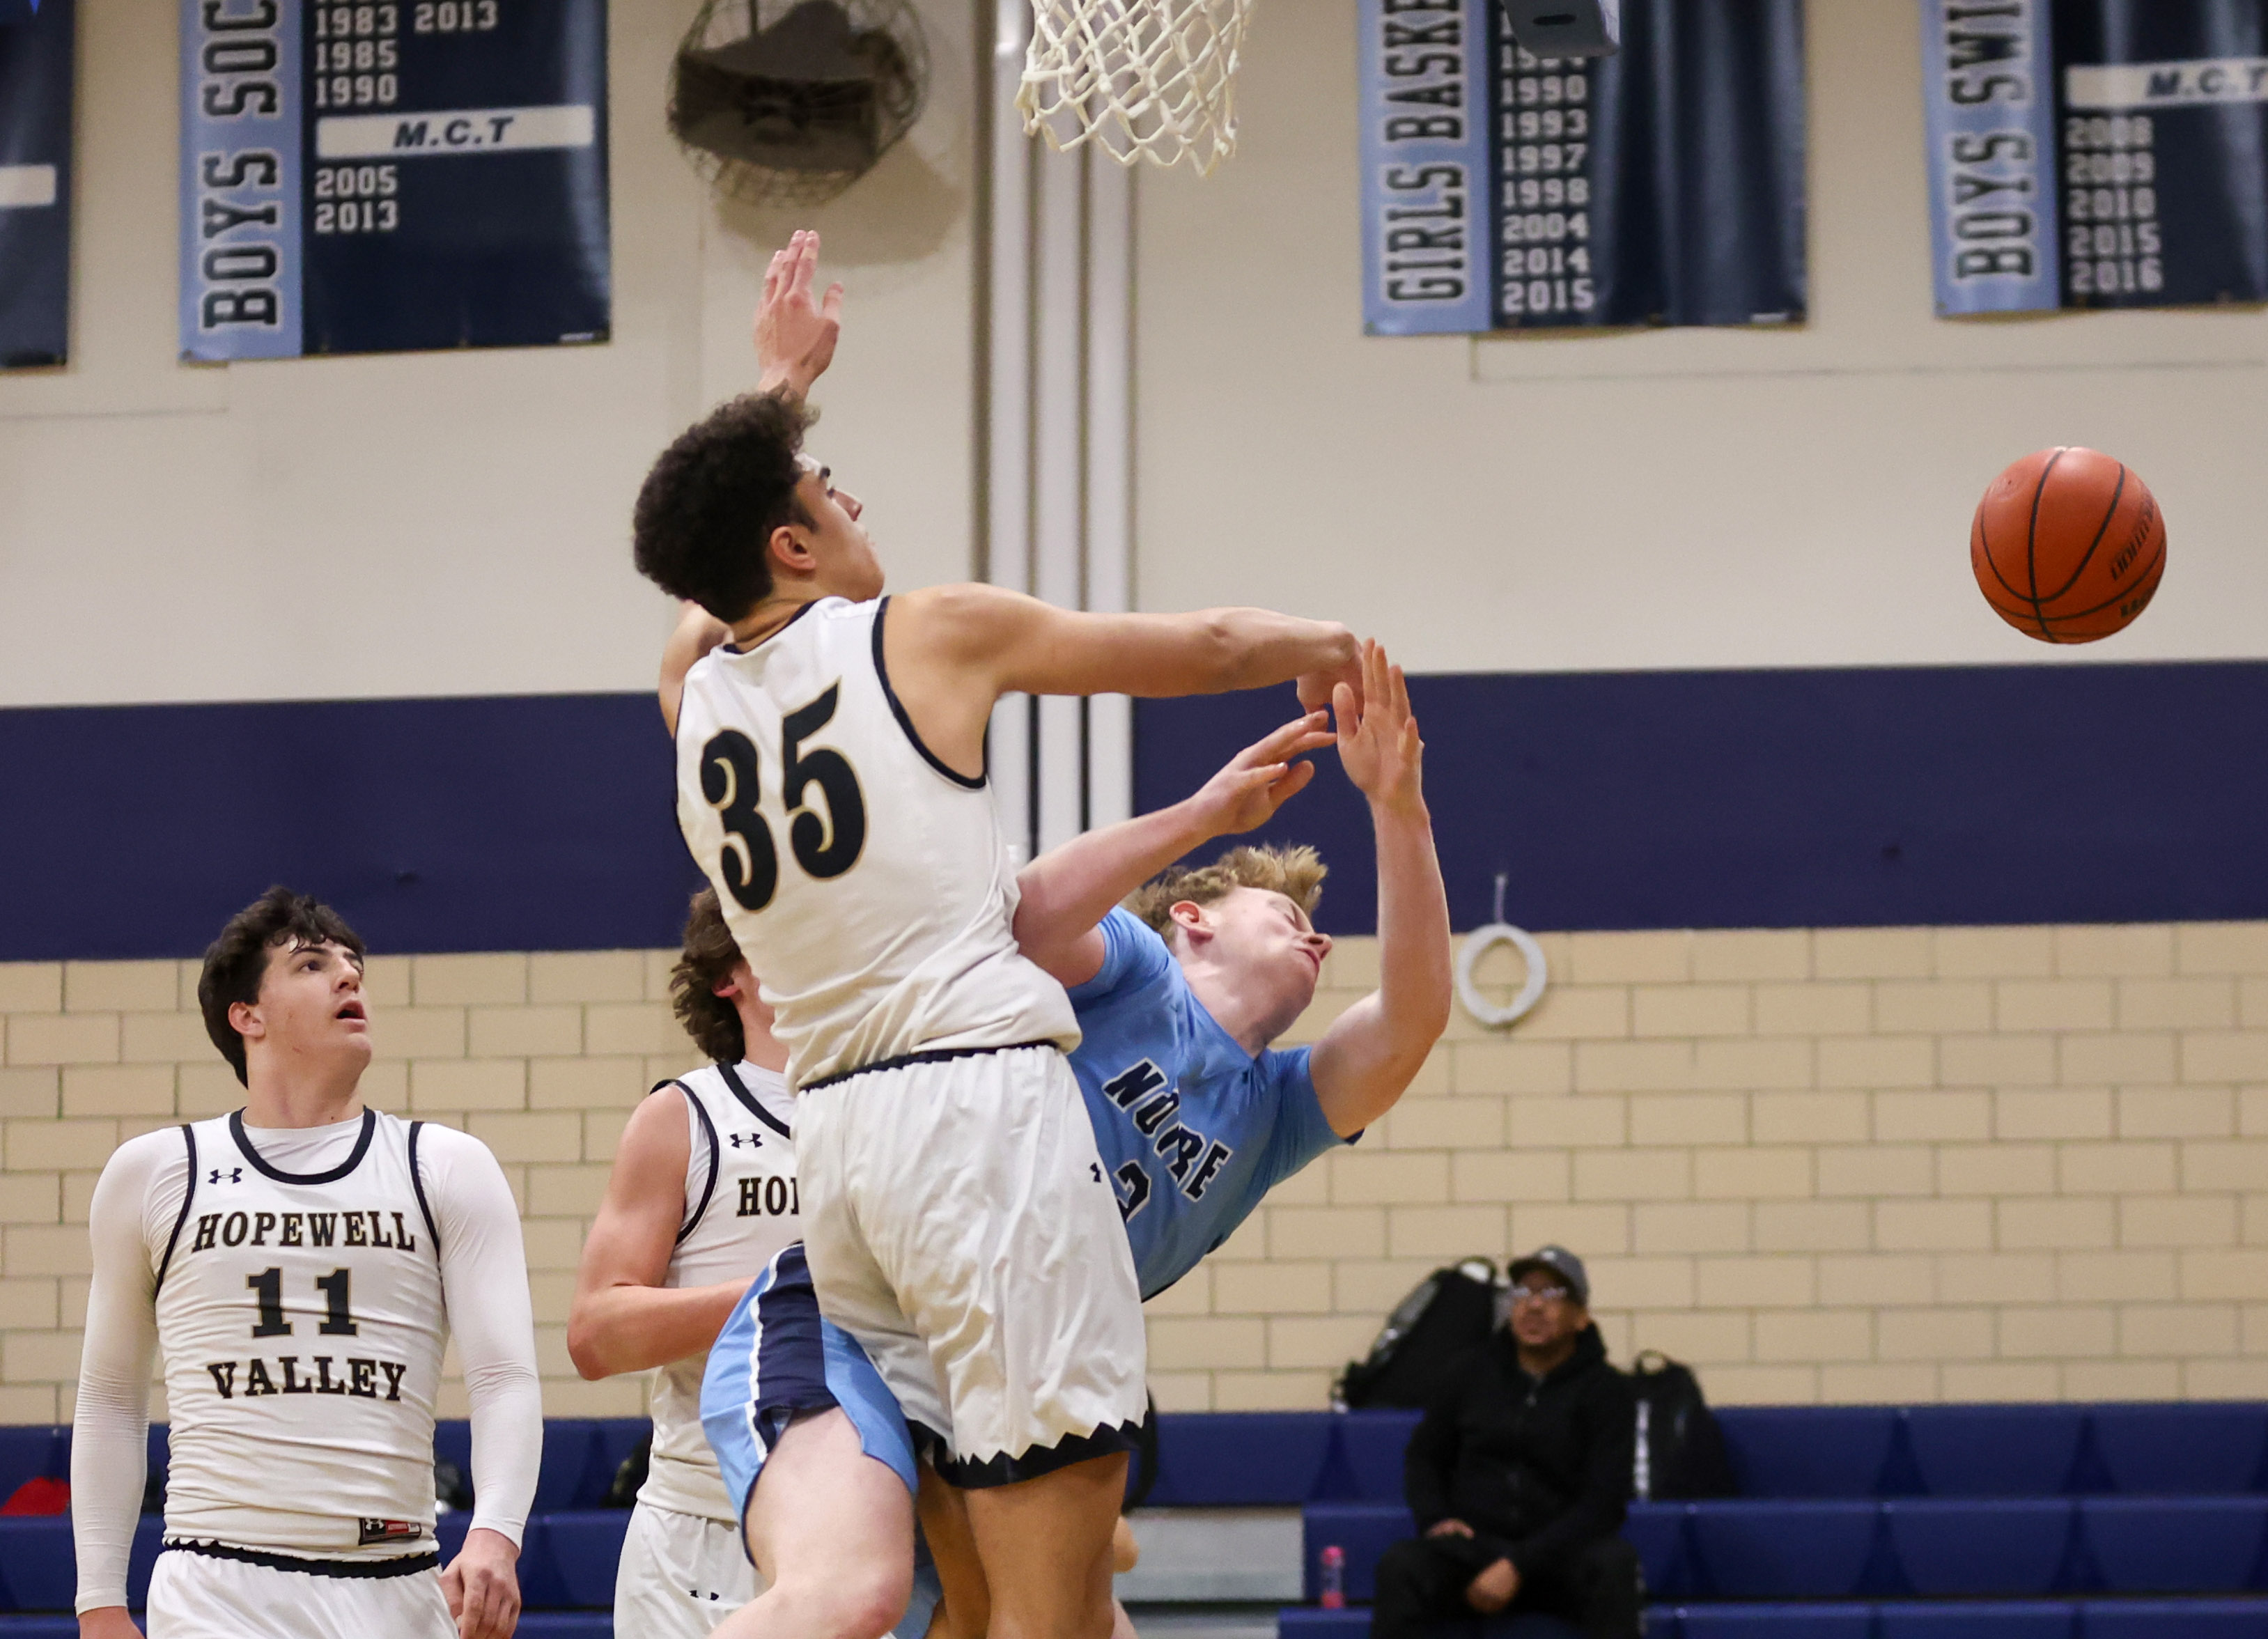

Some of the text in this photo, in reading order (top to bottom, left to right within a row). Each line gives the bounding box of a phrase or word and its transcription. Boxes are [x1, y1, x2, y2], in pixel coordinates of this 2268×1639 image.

[315, 4, 398, 37] 1983
[413, 0, 499, 33] 2013
[315, 39, 398, 71] 1985
[315, 74, 398, 107] 1990
[1501, 75, 1587, 104] 1990
[394, 116, 514, 148] M.C.T
[1501, 109, 1588, 139] 1993
[1502, 143, 1587, 174] 1997
[315, 166, 398, 198] 2005
[1502, 178, 1590, 208] 1998
[315, 201, 398, 233] 2013
[1953, 133, 2033, 278] BOYS
[203, 152, 277, 329] BOYS
[1386, 164, 1462, 300] GIRLS
[1502, 212, 1590, 243] 2004
[2069, 222, 2161, 256] 2015
[1502, 247, 1591, 277] 2014
[2070, 258, 2163, 293] 2016
[1502, 279, 1594, 313] 2015
[700, 675, 869, 915] 35
[192, 1211, 416, 1253] HOPEWELL
[246, 1266, 359, 1338] 11
[208, 1356, 406, 1401] VALLEY
